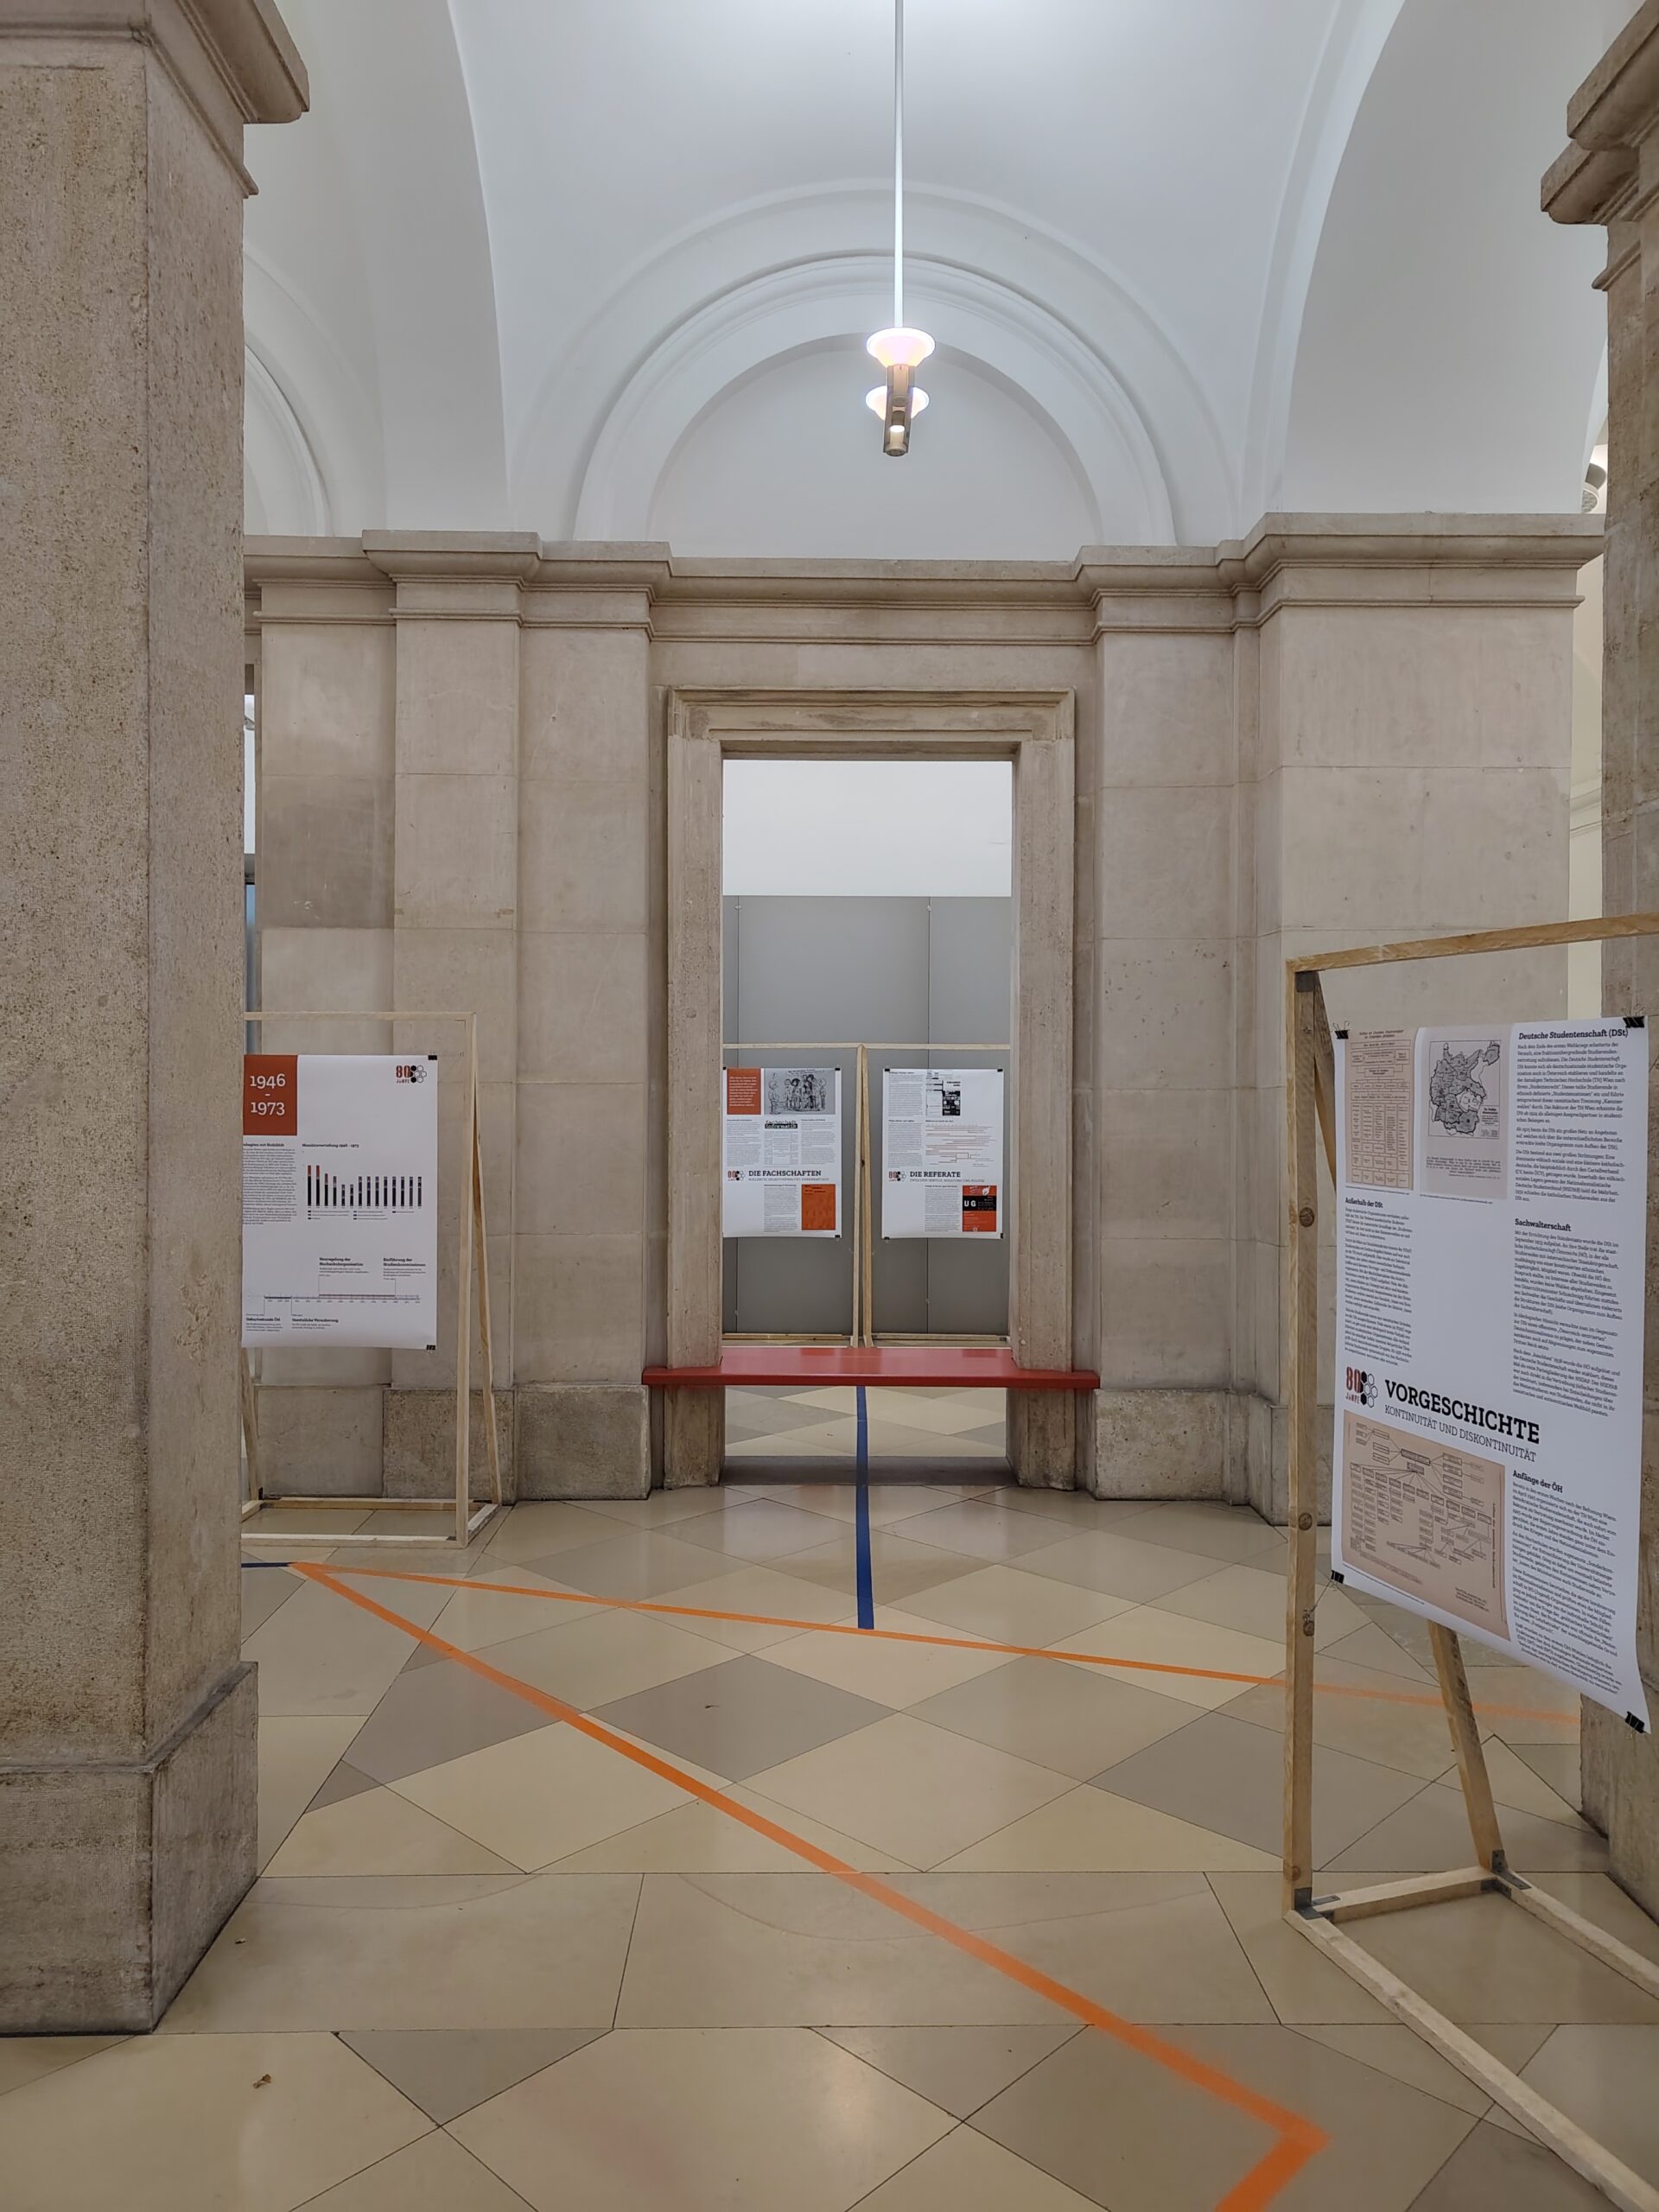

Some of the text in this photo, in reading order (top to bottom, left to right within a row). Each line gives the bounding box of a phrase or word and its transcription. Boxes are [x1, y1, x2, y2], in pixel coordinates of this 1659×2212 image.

[1549, 1029, 1607, 1038] Studentenschaft
[1609, 1029, 1628, 1039] (DSt)
[250, 1073, 286, 1090] 1946
[250, 1102, 285, 1116] 1973
[1515, 1218, 1572, 1231] Sachwalterschaft
[1346, 1366, 1362, 1394] 80
[1385, 1379, 1540, 1445] VORGESCHICHTE
[1385, 1404, 1536, 1463] KONTINUITÄT UND DISKONTINUITÄT
[1513, 1470, 1563, 1492] Anfänge der ÖH
